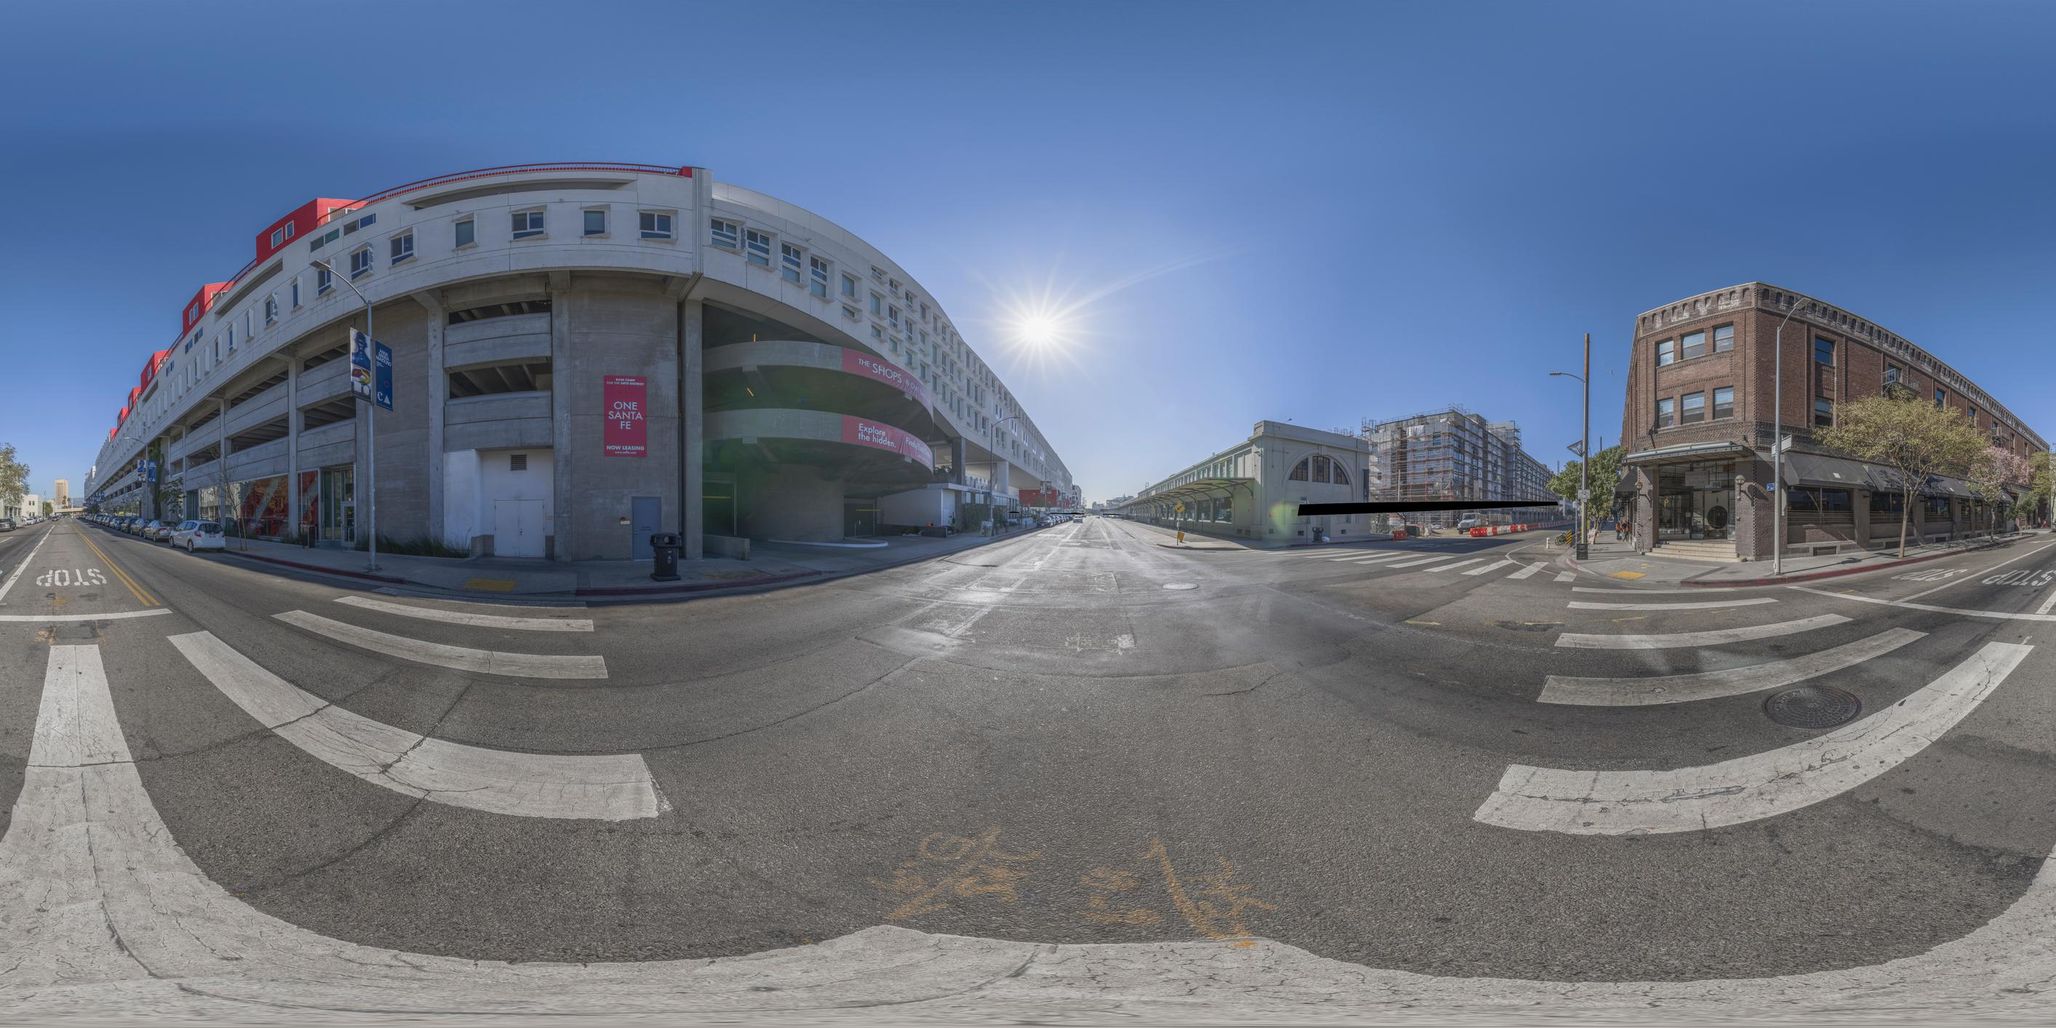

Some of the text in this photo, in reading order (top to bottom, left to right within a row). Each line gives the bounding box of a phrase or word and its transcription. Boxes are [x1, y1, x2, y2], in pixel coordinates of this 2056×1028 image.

[858, 359, 870, 368] THE
[872, 363, 902, 384] SHOPS
[614, 401, 638, 411] ONE
[608, 411, 643, 420] SANTA
[620, 421, 631, 430] FE
[858, 423, 886, 437] Explore
[858, 433, 870, 442] the
[872, 435, 897, 448] hidden.
[36, 568, 107, 587] STOP
[1981, 569, 2056, 587] STOP
